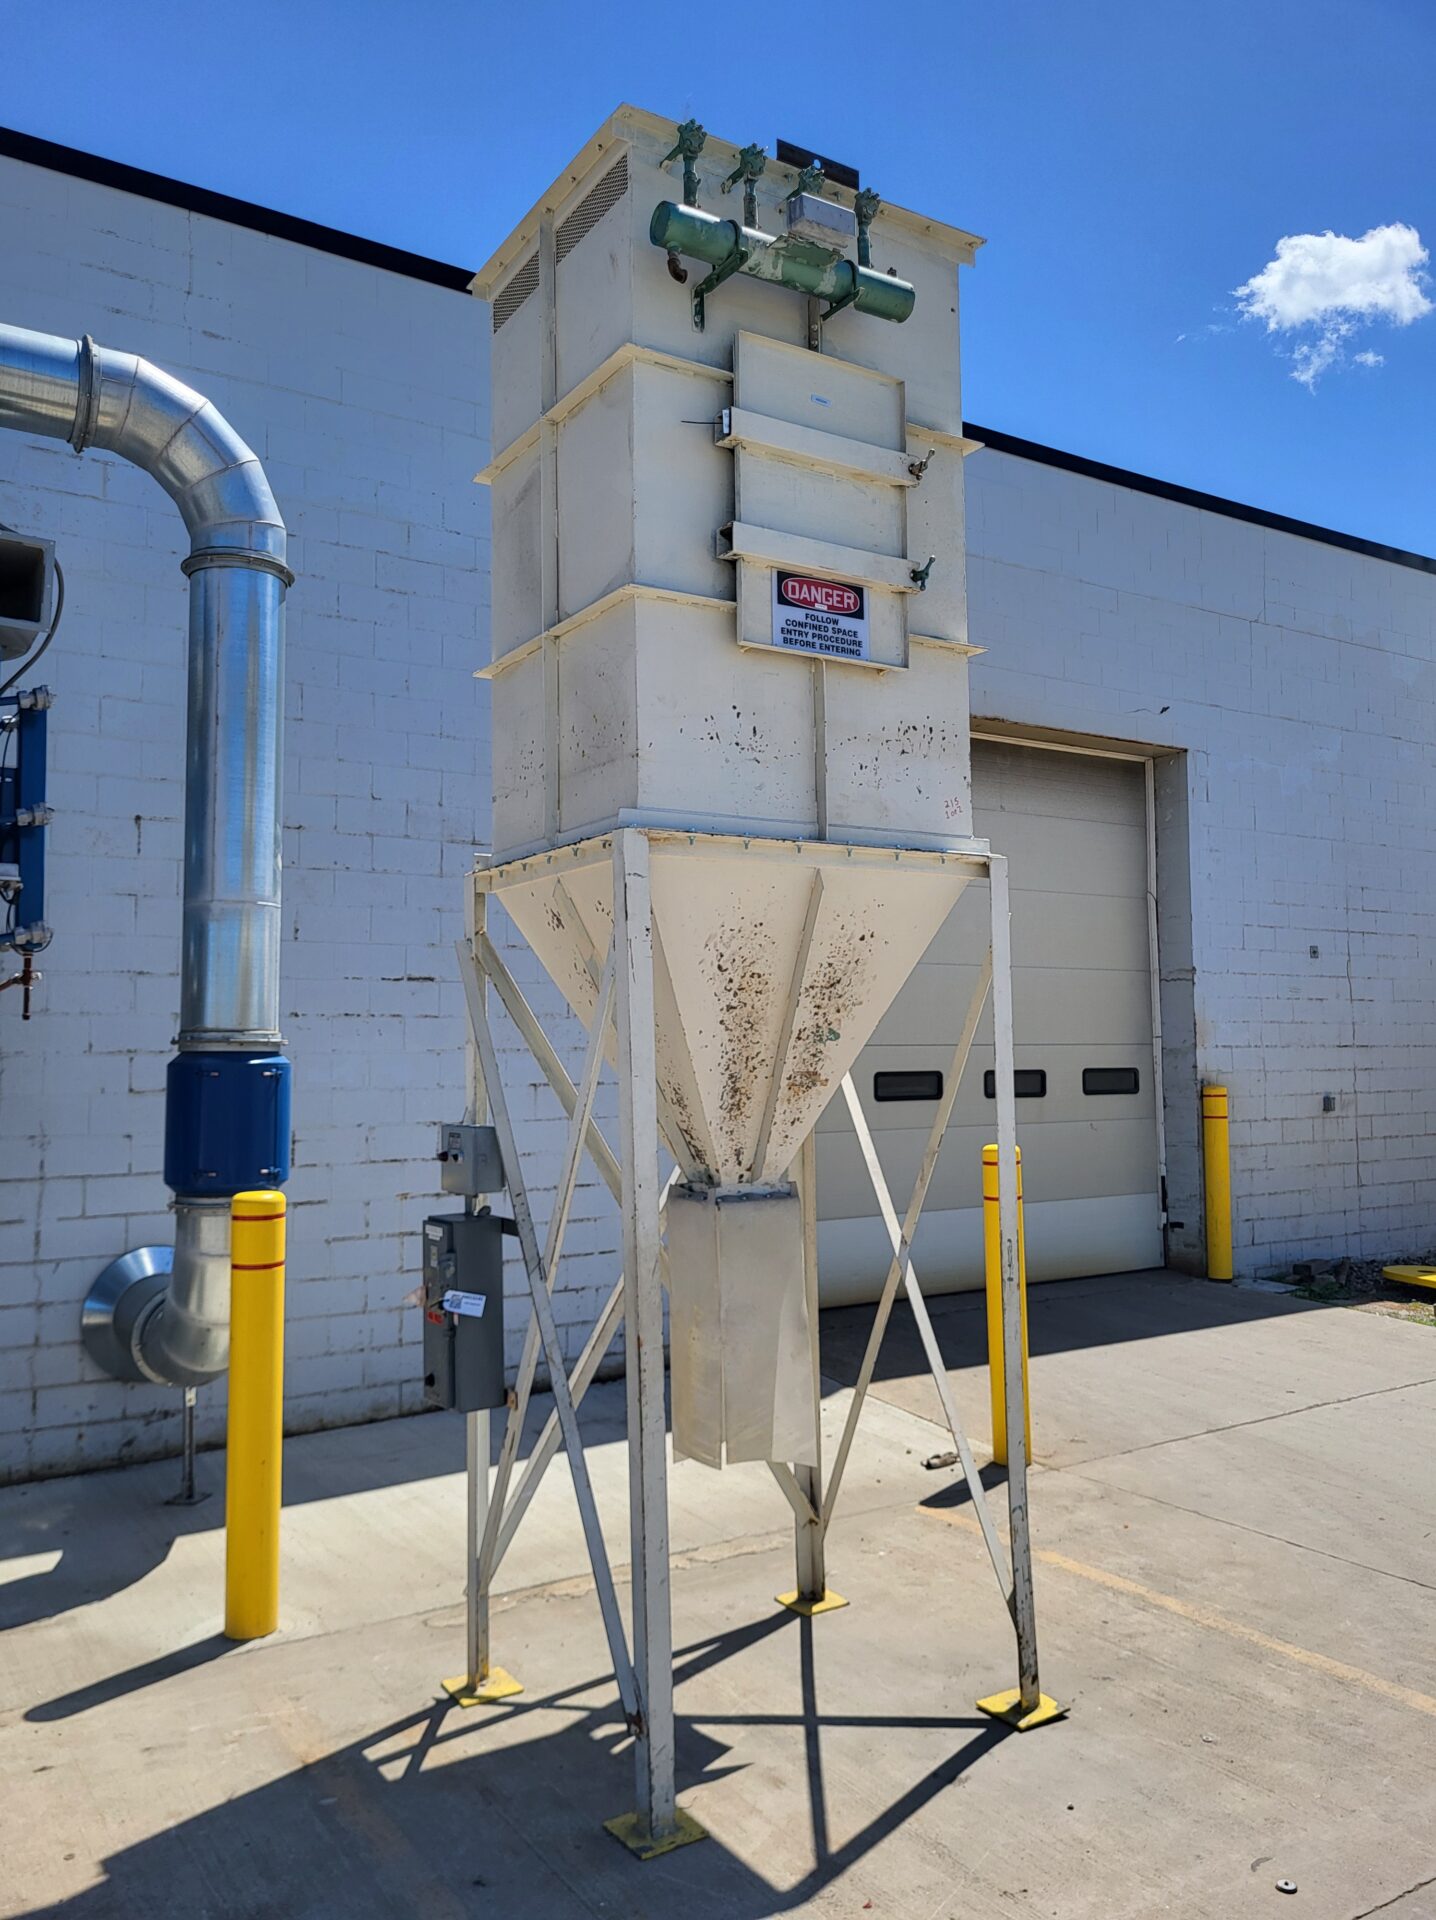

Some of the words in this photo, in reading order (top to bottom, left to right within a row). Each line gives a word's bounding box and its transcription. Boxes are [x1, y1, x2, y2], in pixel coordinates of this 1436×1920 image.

[787, 581, 855, 609] DANGER
[785, 619, 829, 633] CONFINED
[832, 627, 858, 638] SPACE
[805, 613, 839, 626] FOLLOW
[780, 627, 809, 639] ENTRY
[812, 632, 863, 648] PROCEDURE
[783, 637, 816, 649] BEFORE
[819, 643, 861, 656] ENTERING
[944, 796, 959, 808] 215
